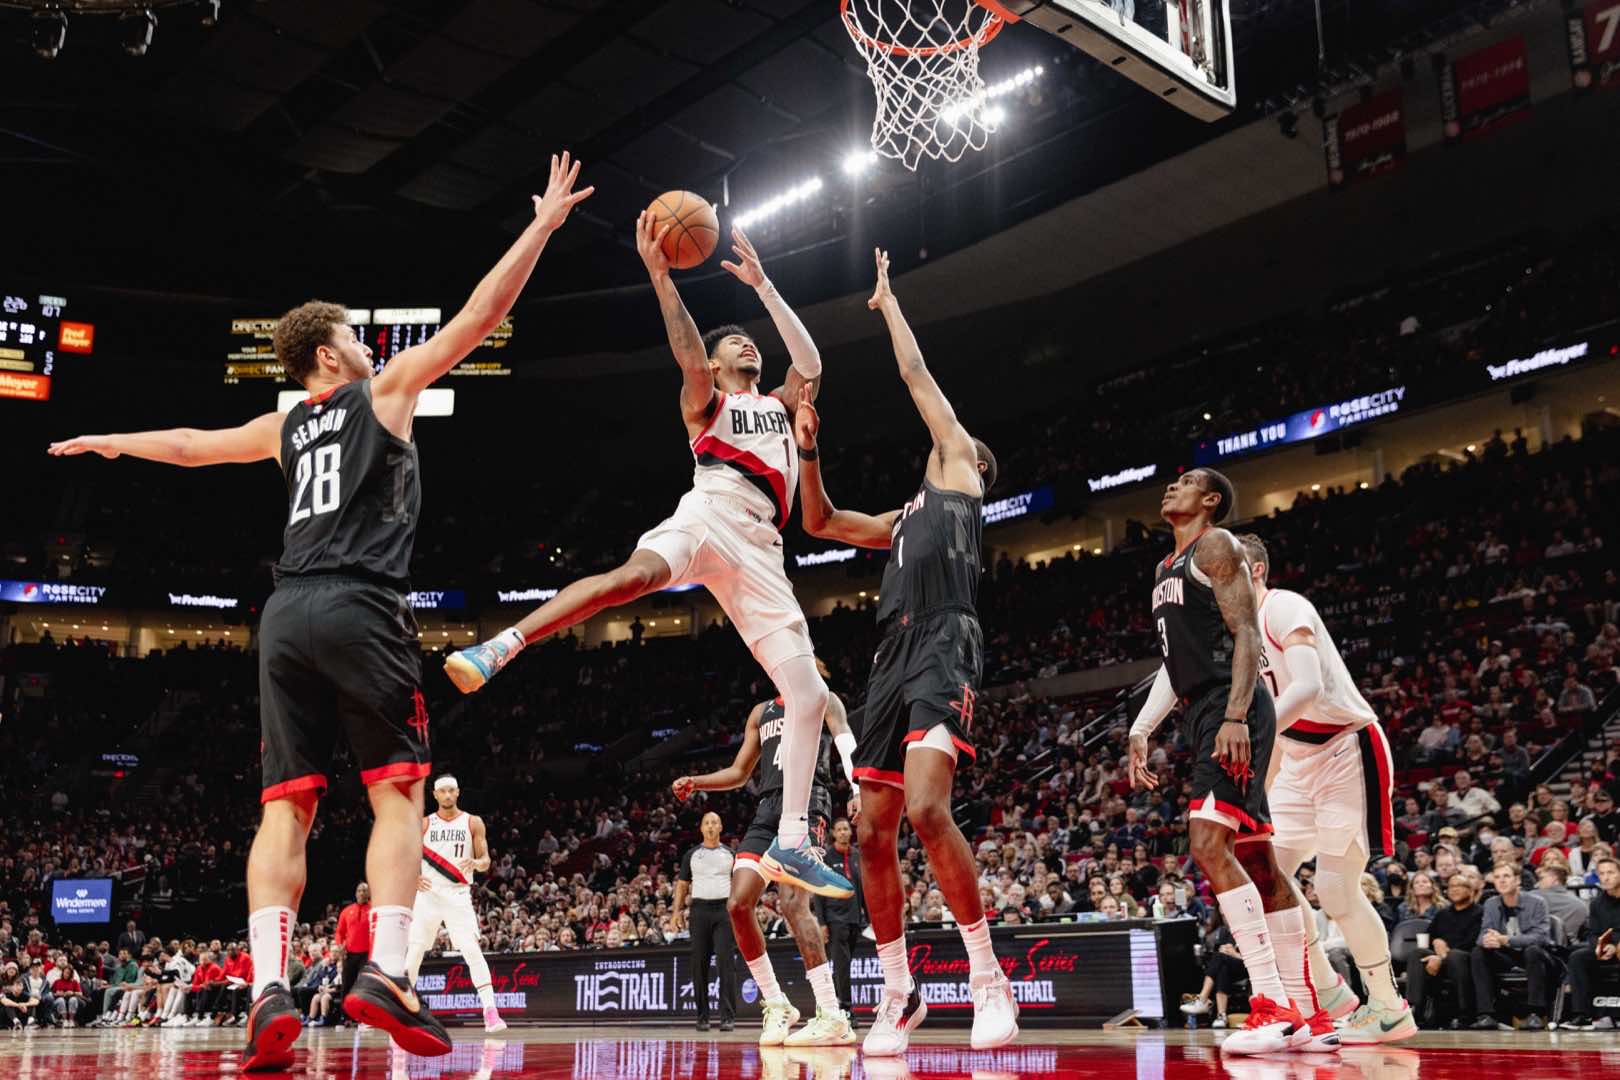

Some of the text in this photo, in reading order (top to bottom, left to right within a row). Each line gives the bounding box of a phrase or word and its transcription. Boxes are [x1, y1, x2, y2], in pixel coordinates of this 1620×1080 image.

[729, 408, 789, 435] BLAZER
[1217, 422, 1287, 455] THANK YOU
[782, 437, 791, 469] 1
[289, 442, 342, 526] 28
[1152, 577, 1185, 614] OUSTON
[1157, 616, 1169, 658] 3
[760, 717, 785, 746] HOUS
[773, 743, 784, 771] 4
[430, 829, 467, 842] BLAZERS
[454, 843, 465, 857] 11
[56, 896, 107, 909] Windermere
[594, 959, 646, 970] INTRODUCING
[850, 957, 885, 979] BLAZE
[1023, 938, 1080, 981] Series
[416, 974, 446, 991] BLAZERS
[860, 985, 872, 1004] AT
[1592, 996, 1620, 1008] GE
